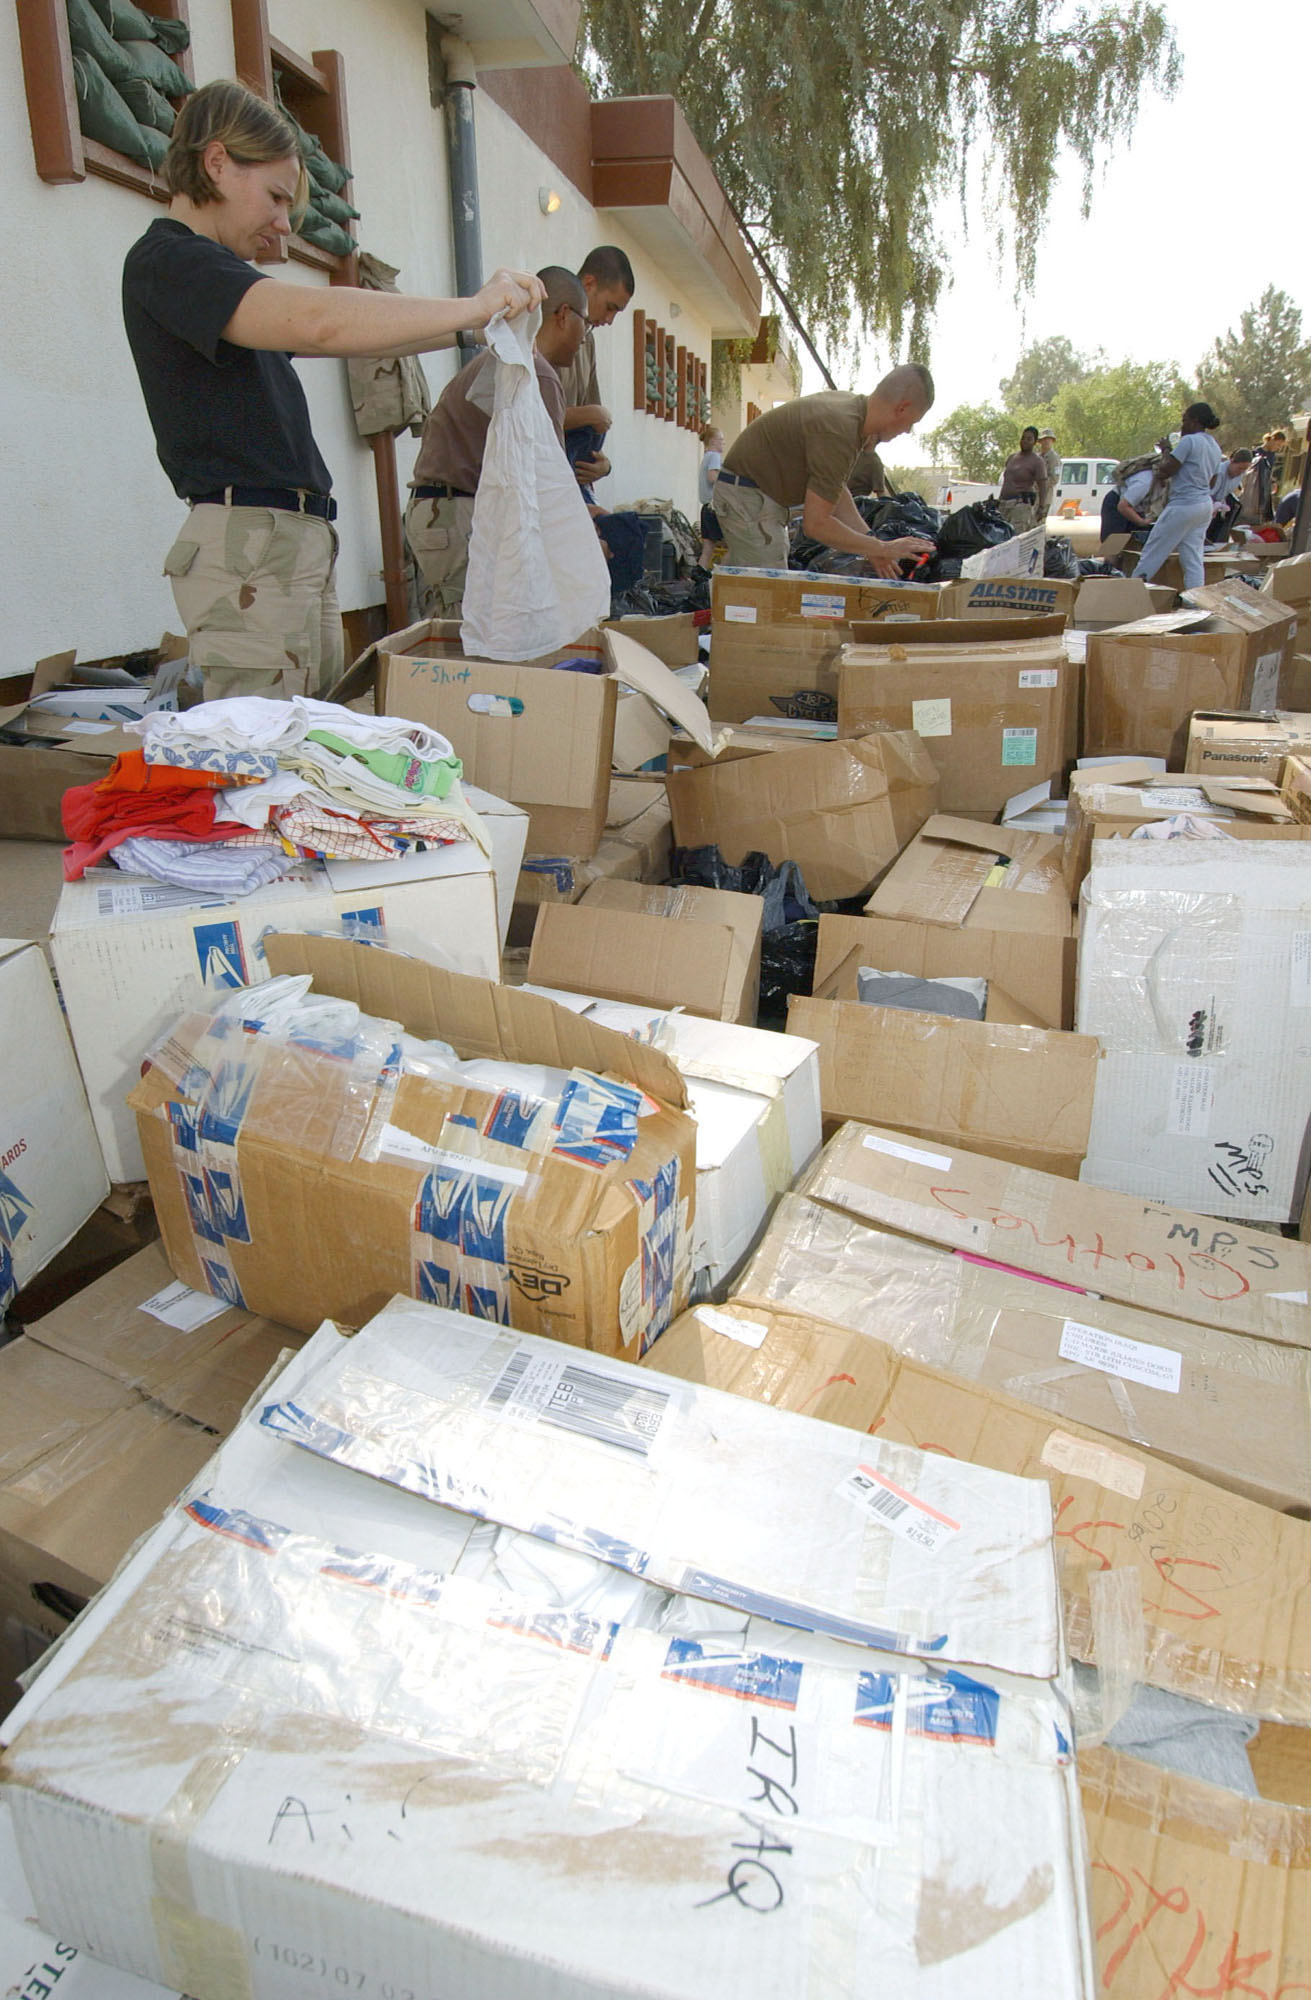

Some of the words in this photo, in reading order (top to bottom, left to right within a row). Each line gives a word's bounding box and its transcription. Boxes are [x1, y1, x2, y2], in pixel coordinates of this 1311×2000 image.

[969, 583, 1058, 604] ALLSTATE
[1202, 750, 1269, 764] Panasonic
[930, 1185, 1250, 1301] Clothes
[549, 1381, 574, 1408] TEB
[693, 1715, 799, 1913] IRAQ
[20, 1941, 78, 2000] STE
